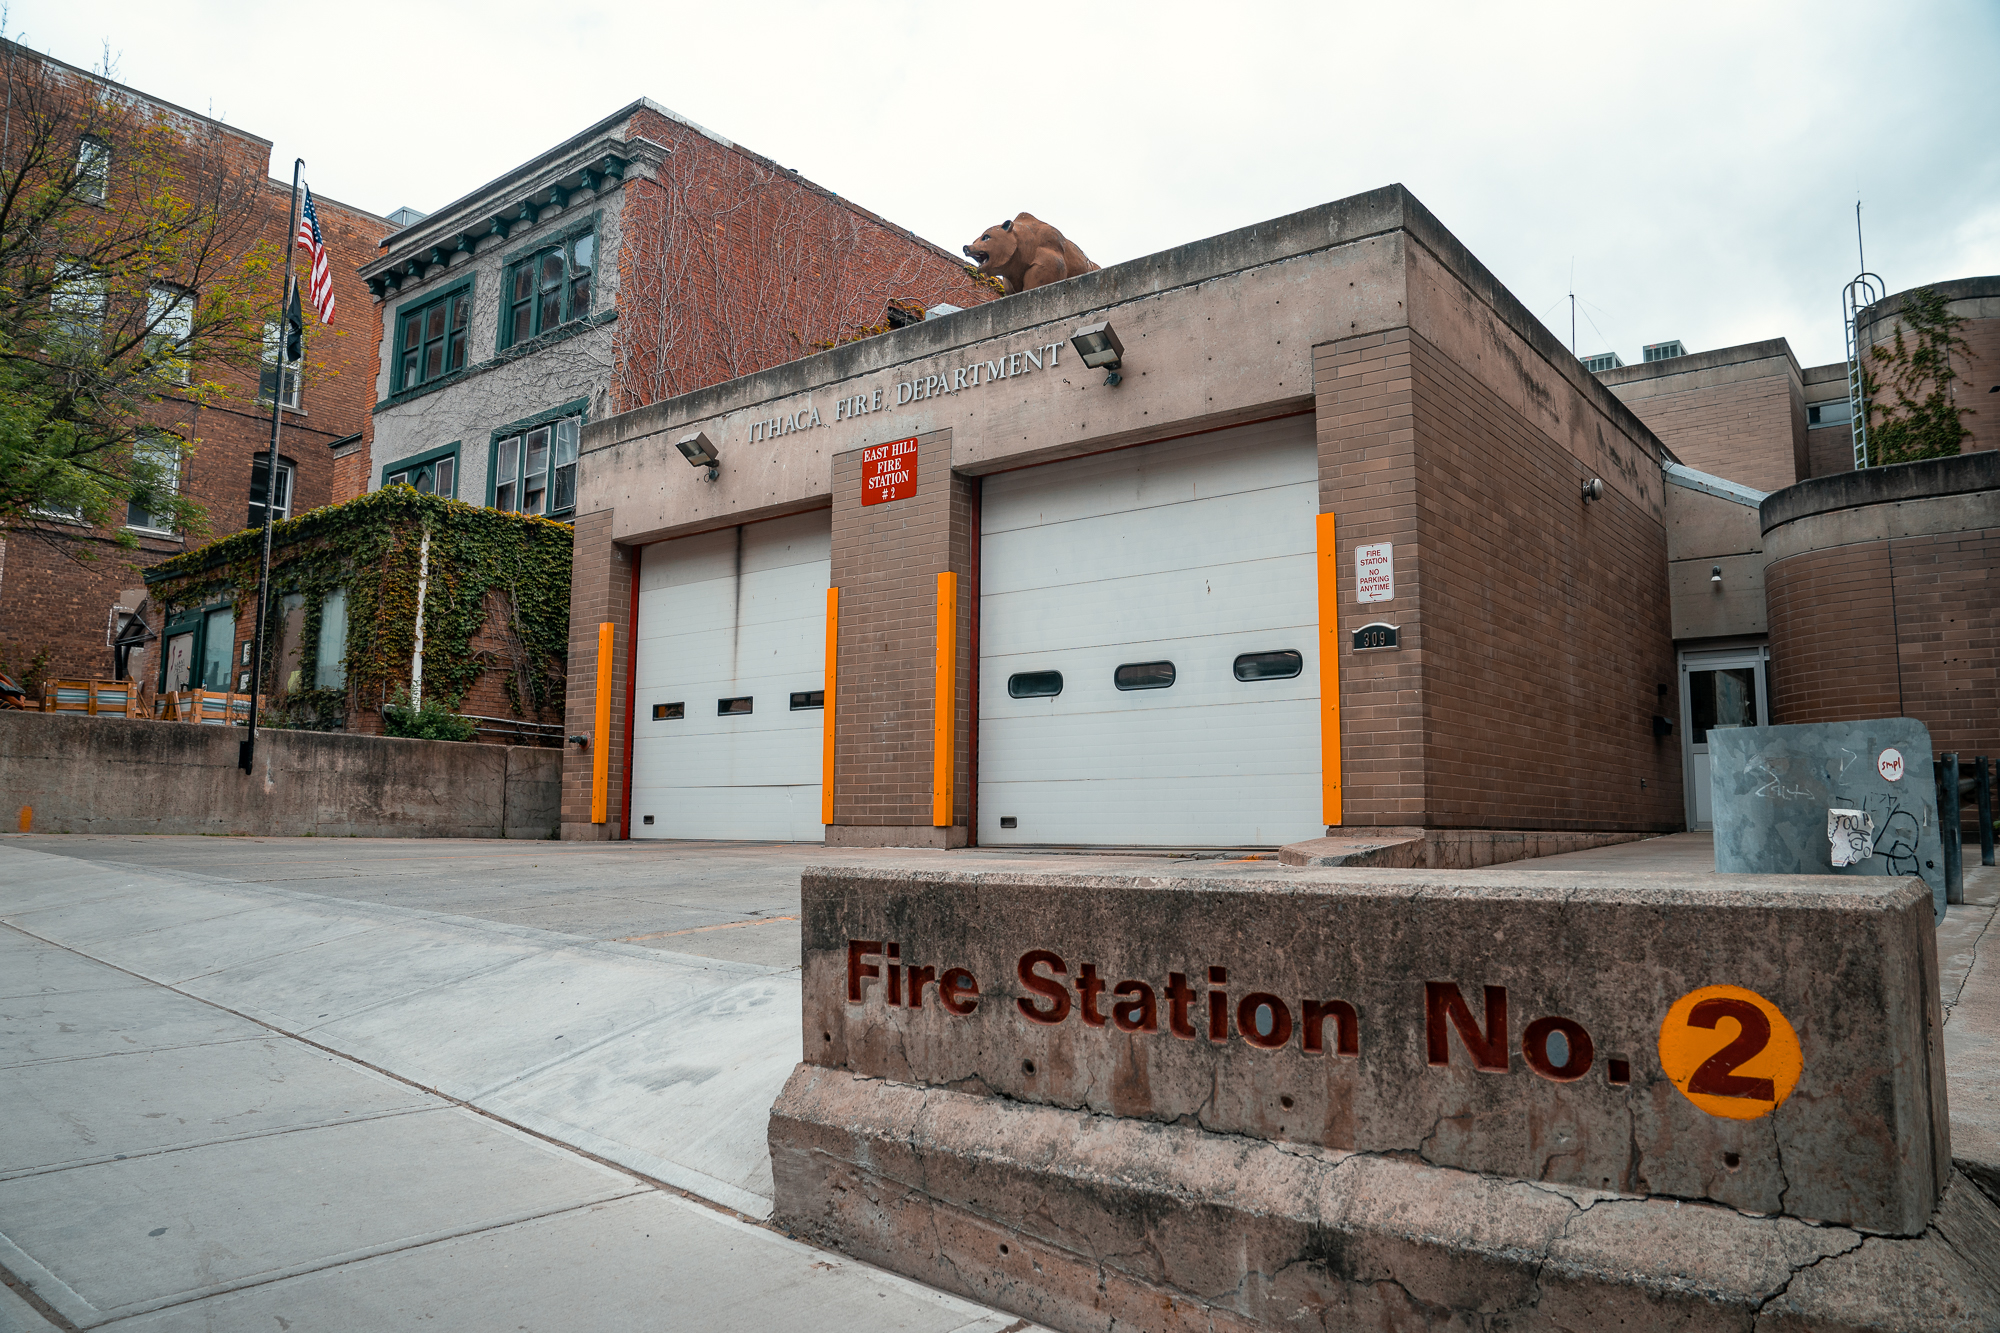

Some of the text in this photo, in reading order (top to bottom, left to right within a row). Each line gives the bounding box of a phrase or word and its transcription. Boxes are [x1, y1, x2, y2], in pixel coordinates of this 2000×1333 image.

[748, 340, 1065, 443] ITHACA FIRE DEPARTMENT
[863, 439, 917, 463] EAST HILL
[876, 457, 902, 475] FIRE
[868, 469, 910, 490] STATION
[1366, 549, 1381, 557] FIRE
[1360, 557, 1388, 566] STATION
[1360, 575, 1390, 584] PARKING
[1369, 568, 1380, 576] NO
[1360, 583, 1390, 592] ANYTIME
[1363, 631, 1386, 647] 309
[847, 939, 1776, 1102] Fire Station No. 2
